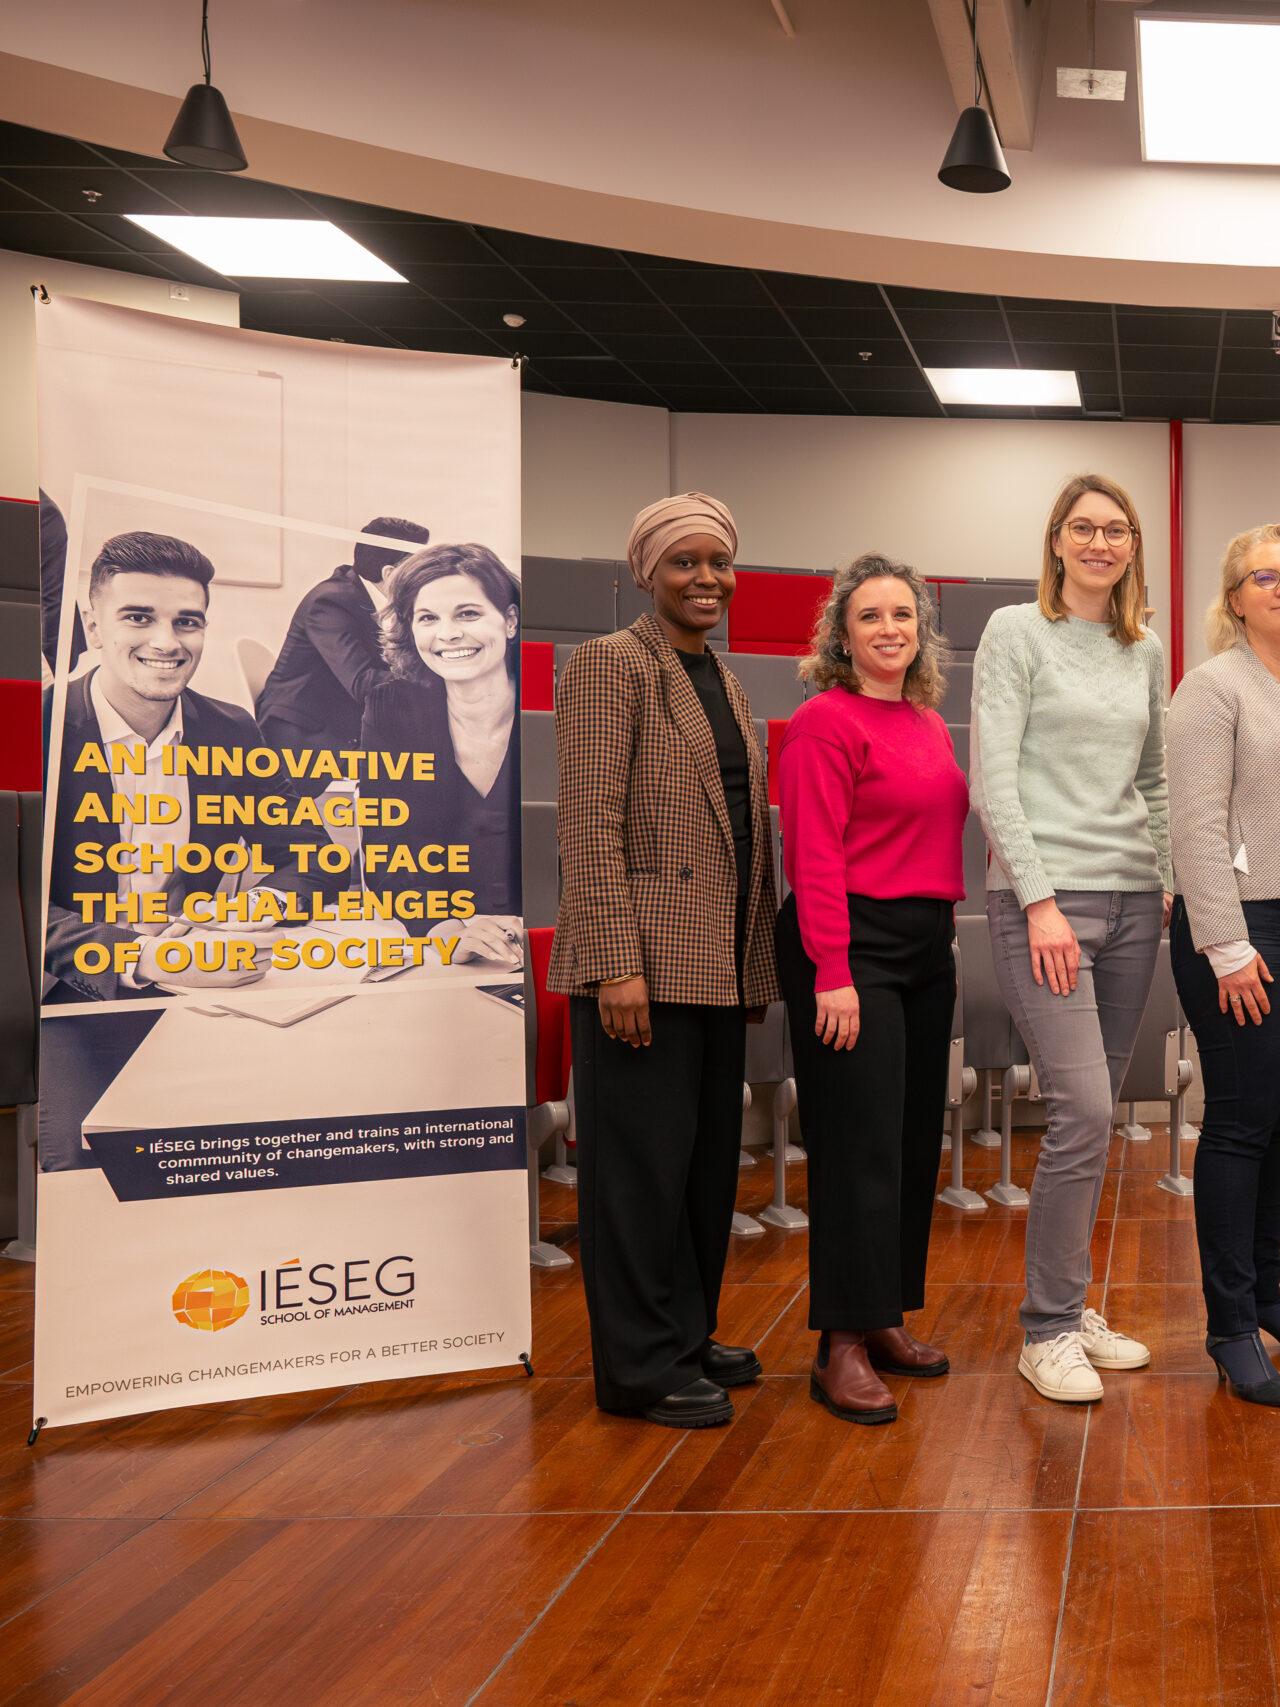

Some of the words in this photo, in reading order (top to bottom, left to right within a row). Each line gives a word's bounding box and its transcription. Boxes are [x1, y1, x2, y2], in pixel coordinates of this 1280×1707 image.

[74, 742, 145, 774] AN
[162, 745, 434, 780] INNOVATIVE
[74, 792, 180, 823] AND
[197, 795, 409, 826] ENGAGED
[74, 842, 274, 873] SCHOOL
[290, 844, 350, 873] TO
[366, 845, 469, 873] FACE
[73, 893, 167, 923] THE
[183, 890, 475, 922] CHALLENGES
[74, 942, 139, 974] OF
[155, 941, 256, 972] OUR
[272, 936, 459, 969] SOCIETY
[150, 1139, 195, 1153] IÉSEG
[201, 1138, 250, 1150] brings
[255, 1133, 321, 1147] together
[326, 1129, 353, 1140] and
[358, 1127, 399, 1138] trains
[404, 1127, 420, 1135] an
[426, 1119, 513, 1133] international
[159, 1152, 261, 1169] commmunity
[266, 1150, 282, 1160] of
[287, 1140, 399, 1159] changemakers,
[404, 1139, 435, 1150] with
[440, 1137, 484, 1147] strong
[489, 1133, 513, 1144] and
[167, 1170, 220, 1184] shared
[226, 1168, 278, 1179] values.
[261, 1256, 414, 1311] IÉSEG
[261, 1312, 311, 1325] SCHOOL
[314, 1309, 330, 1319] OF
[335, 1299, 414, 1316] MANAGEMENT
[66, 1373, 182, 1398] EMPOWERING
[189, 1354, 324, 1381] CHANGEMAKERS
[331, 1350, 361, 1363] FOR
[366, 1348, 376, 1359] A
[382, 1340, 437, 1357] BETTER
[443, 1332, 504, 1349] SOCIETY
